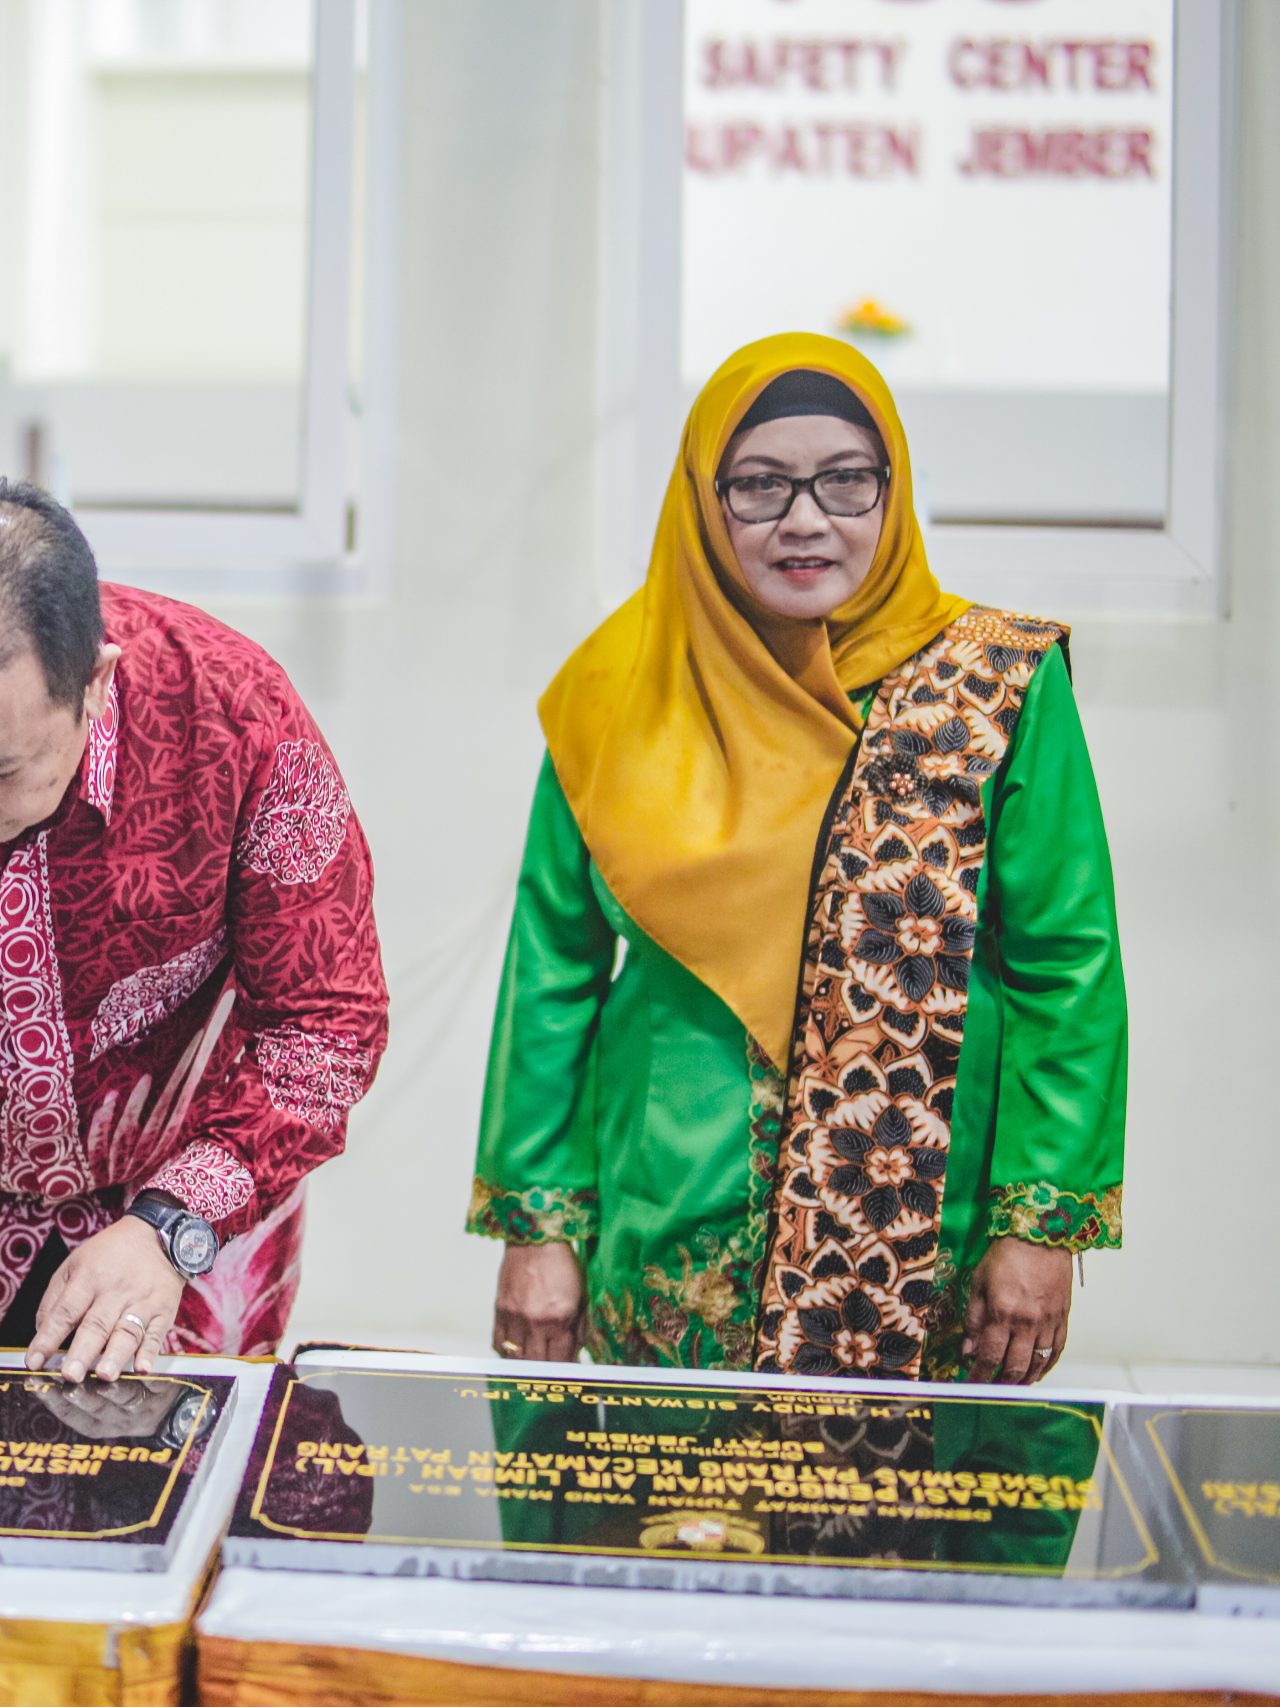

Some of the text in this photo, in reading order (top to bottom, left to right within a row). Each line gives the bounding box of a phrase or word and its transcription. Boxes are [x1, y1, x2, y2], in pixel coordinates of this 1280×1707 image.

[704, 36, 1157, 92] SAFETY CENTER
[958, 128, 1157, 179] JEMBER
[753, 1402, 857, 1417] HENDY
[566, 1431, 825, 1454] BUPATI JEMBER
[297, 1441, 1098, 1493] PUSKESMAS PATRANG KECAMATAN PATRANG
[422, 1463, 561, 1486] LIMBAH
[576, 1471, 636, 1489] AIR
[653, 1475, 899, 1504] PENGOLAHAN
[564, 1491, 636, 1505] YANG
[648, 1496, 742, 1511] TUHAN
[911, 1487, 1103, 1510] INSTALASI
